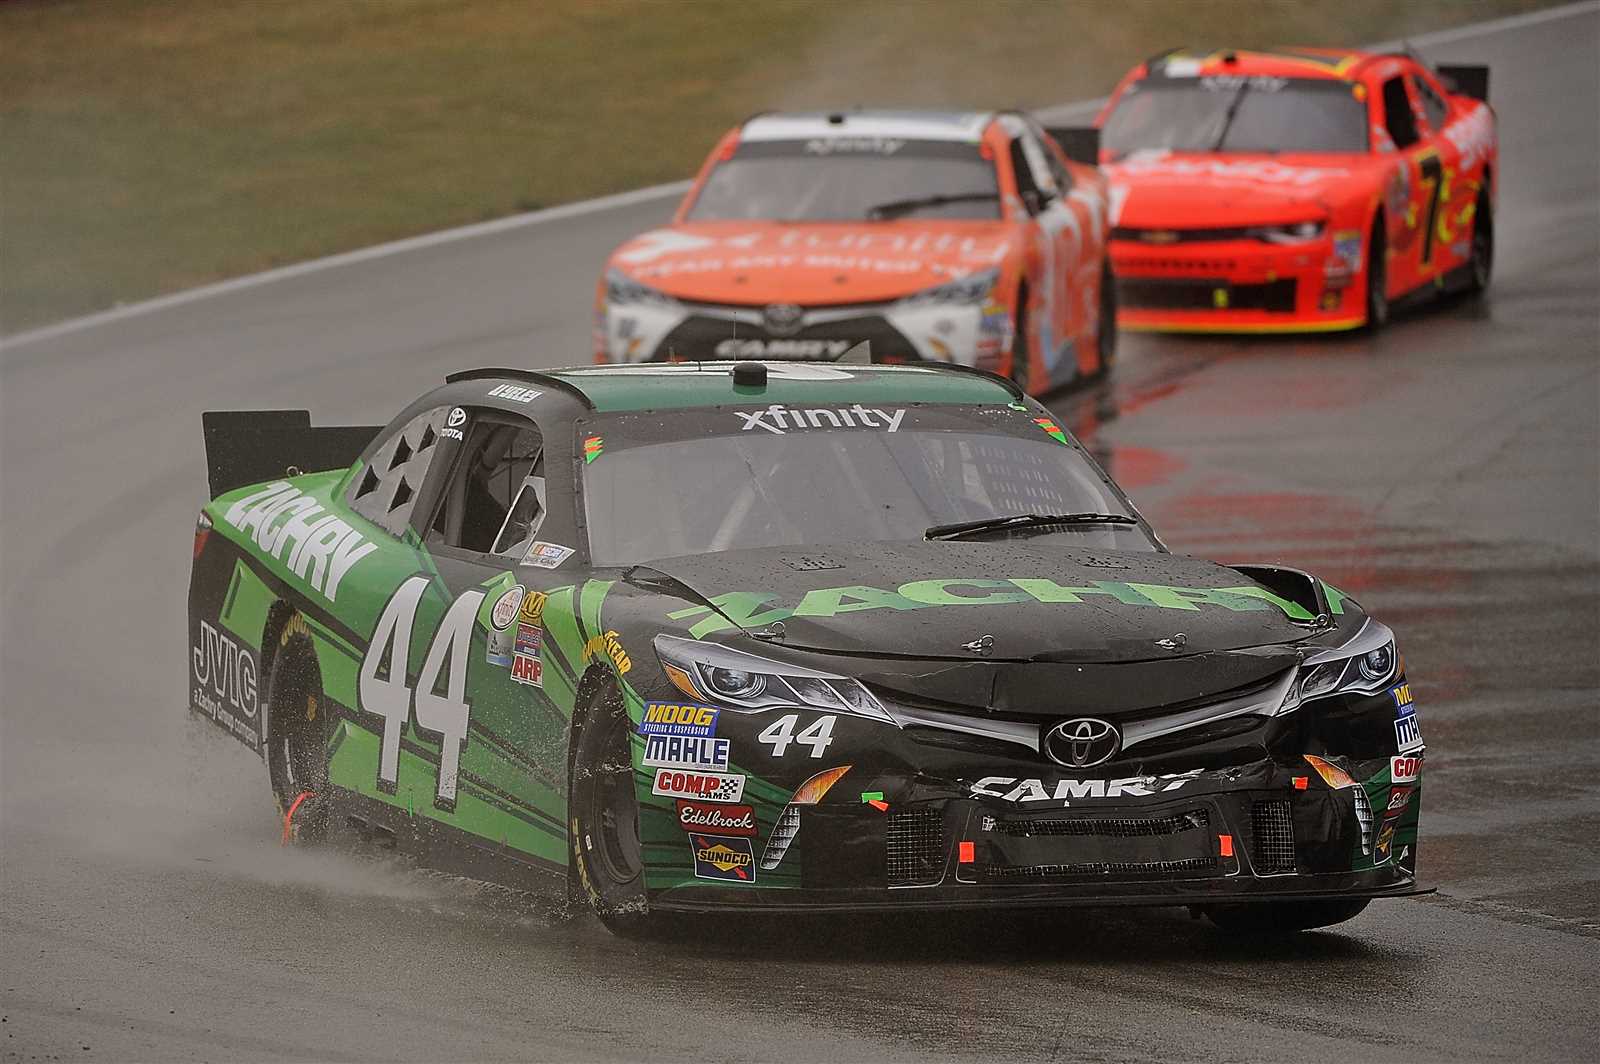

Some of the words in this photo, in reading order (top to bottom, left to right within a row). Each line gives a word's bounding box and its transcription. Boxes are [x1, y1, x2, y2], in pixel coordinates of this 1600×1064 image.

[734, 404, 906, 435] xfinity
[224, 481, 378, 602] ZACHRY
[513, 655, 542, 682] ARP
[360, 576, 488, 799] 44
[644, 704, 718, 726] MOOG
[643, 723, 667, 733] STEERING
[674, 725, 710, 736] SUSPENSION
[757, 714, 838, 759] 44
[646, 736, 728, 764] MAHLE
[658, 772, 721, 794] COMP
[698, 791, 732, 800] CAMS
[680, 806, 754, 829] Edelbrock
[699, 850, 749, 865] SUNOCO
